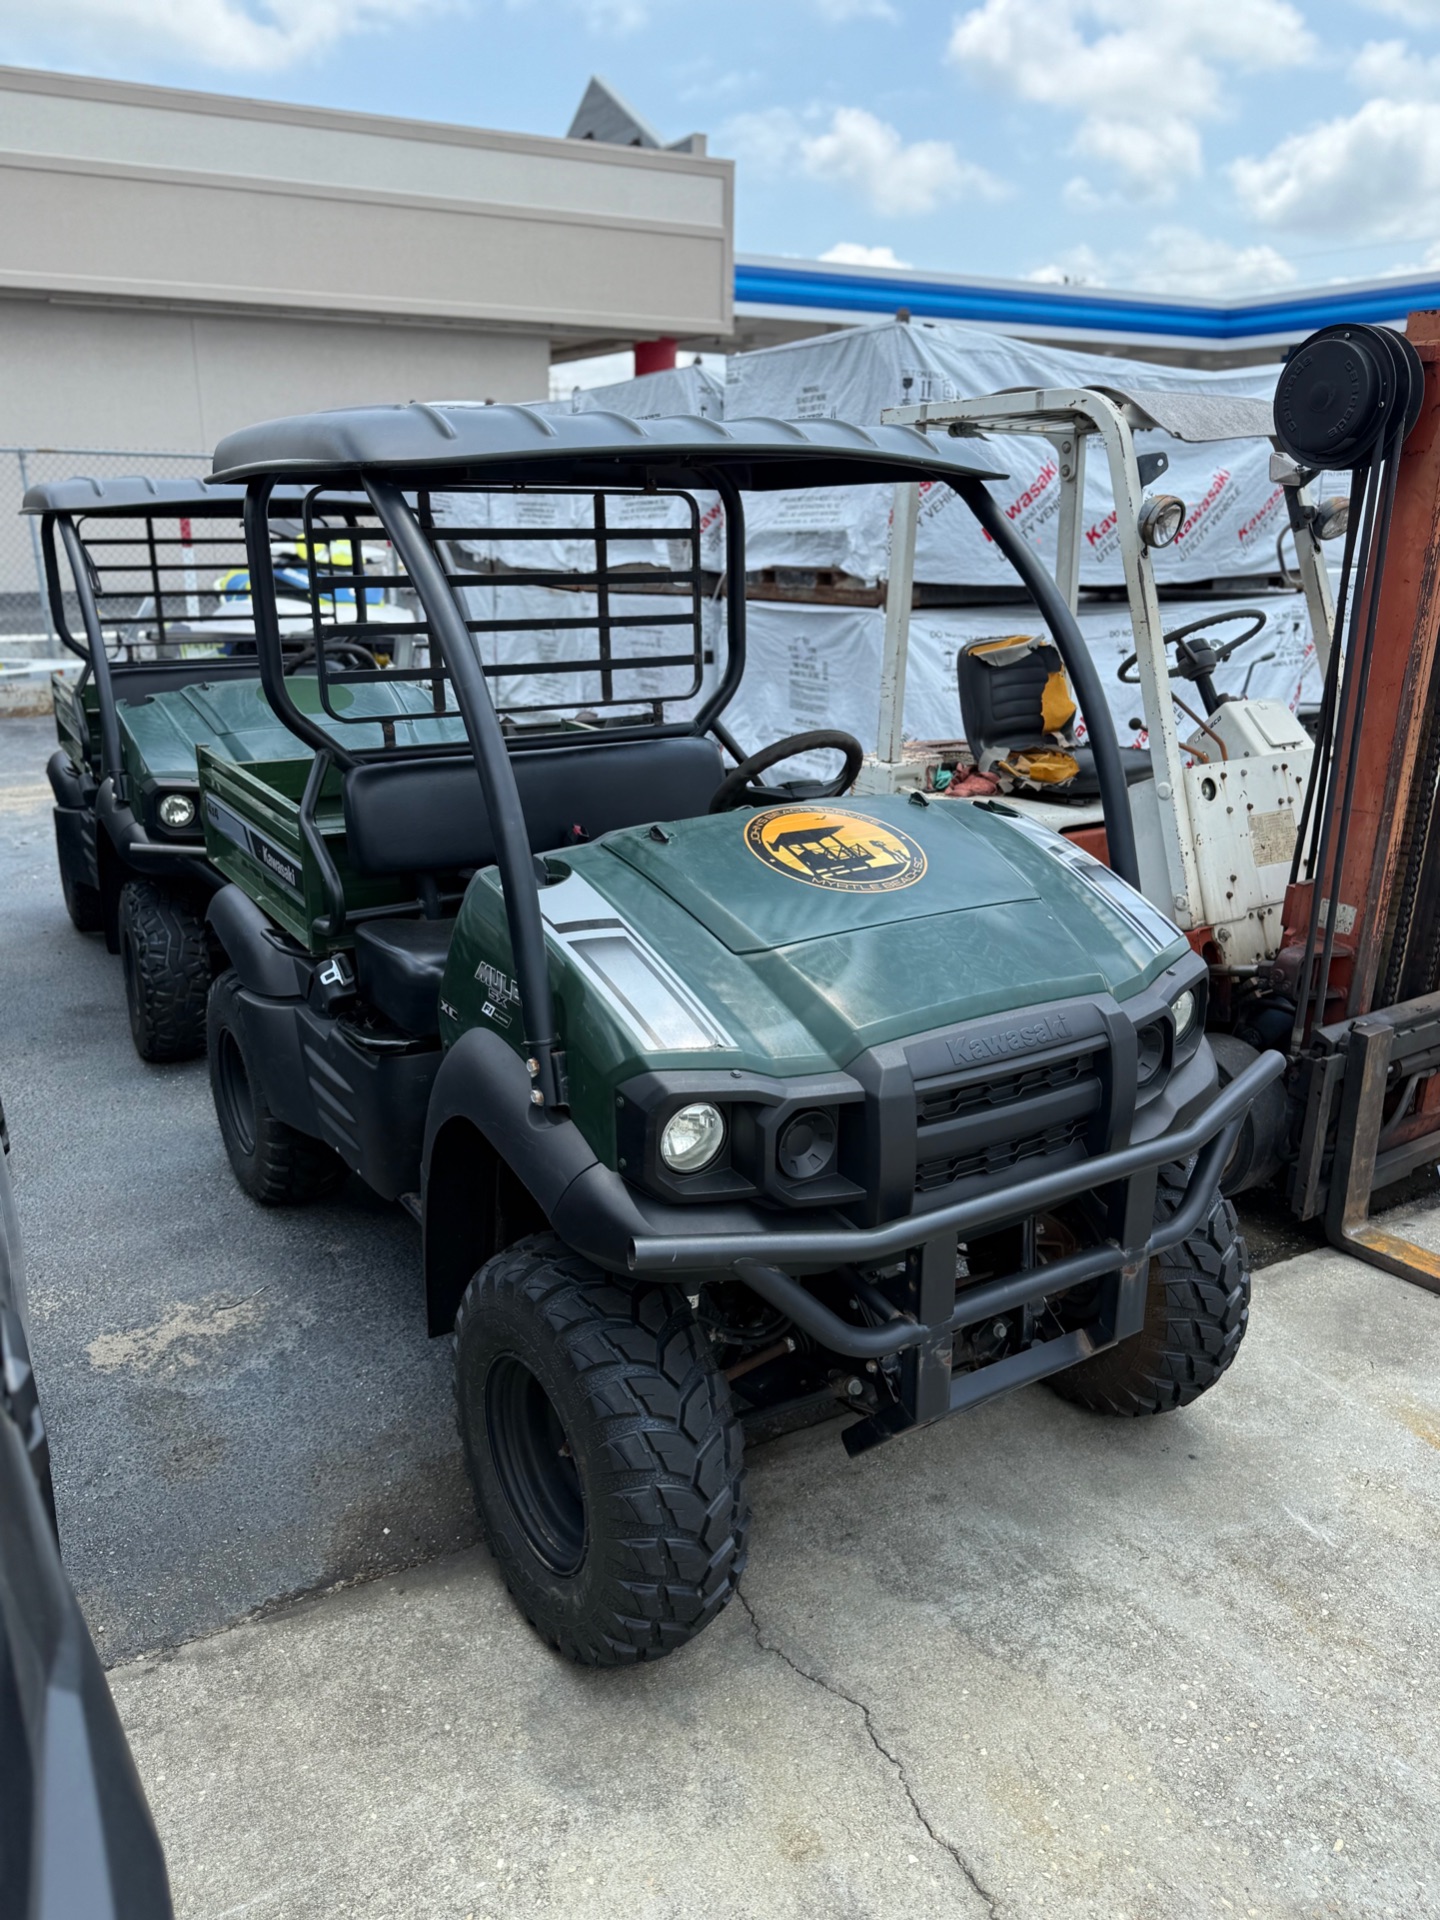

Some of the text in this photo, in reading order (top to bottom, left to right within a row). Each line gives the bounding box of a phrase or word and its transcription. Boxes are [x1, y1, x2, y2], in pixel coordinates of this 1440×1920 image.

[924, 487, 958, 519] VEHIC
[1210, 485, 1242, 527] VEHICLE
[1122, 629, 1132, 637] NO
[262, 845, 296, 886] Kawasaki
[811, 876, 882, 891] MYRTLE
[474, 960, 522, 1007] MULE
[440, 999, 458, 1021] XC
[944, 1012, 1073, 1066] Kawasaki
